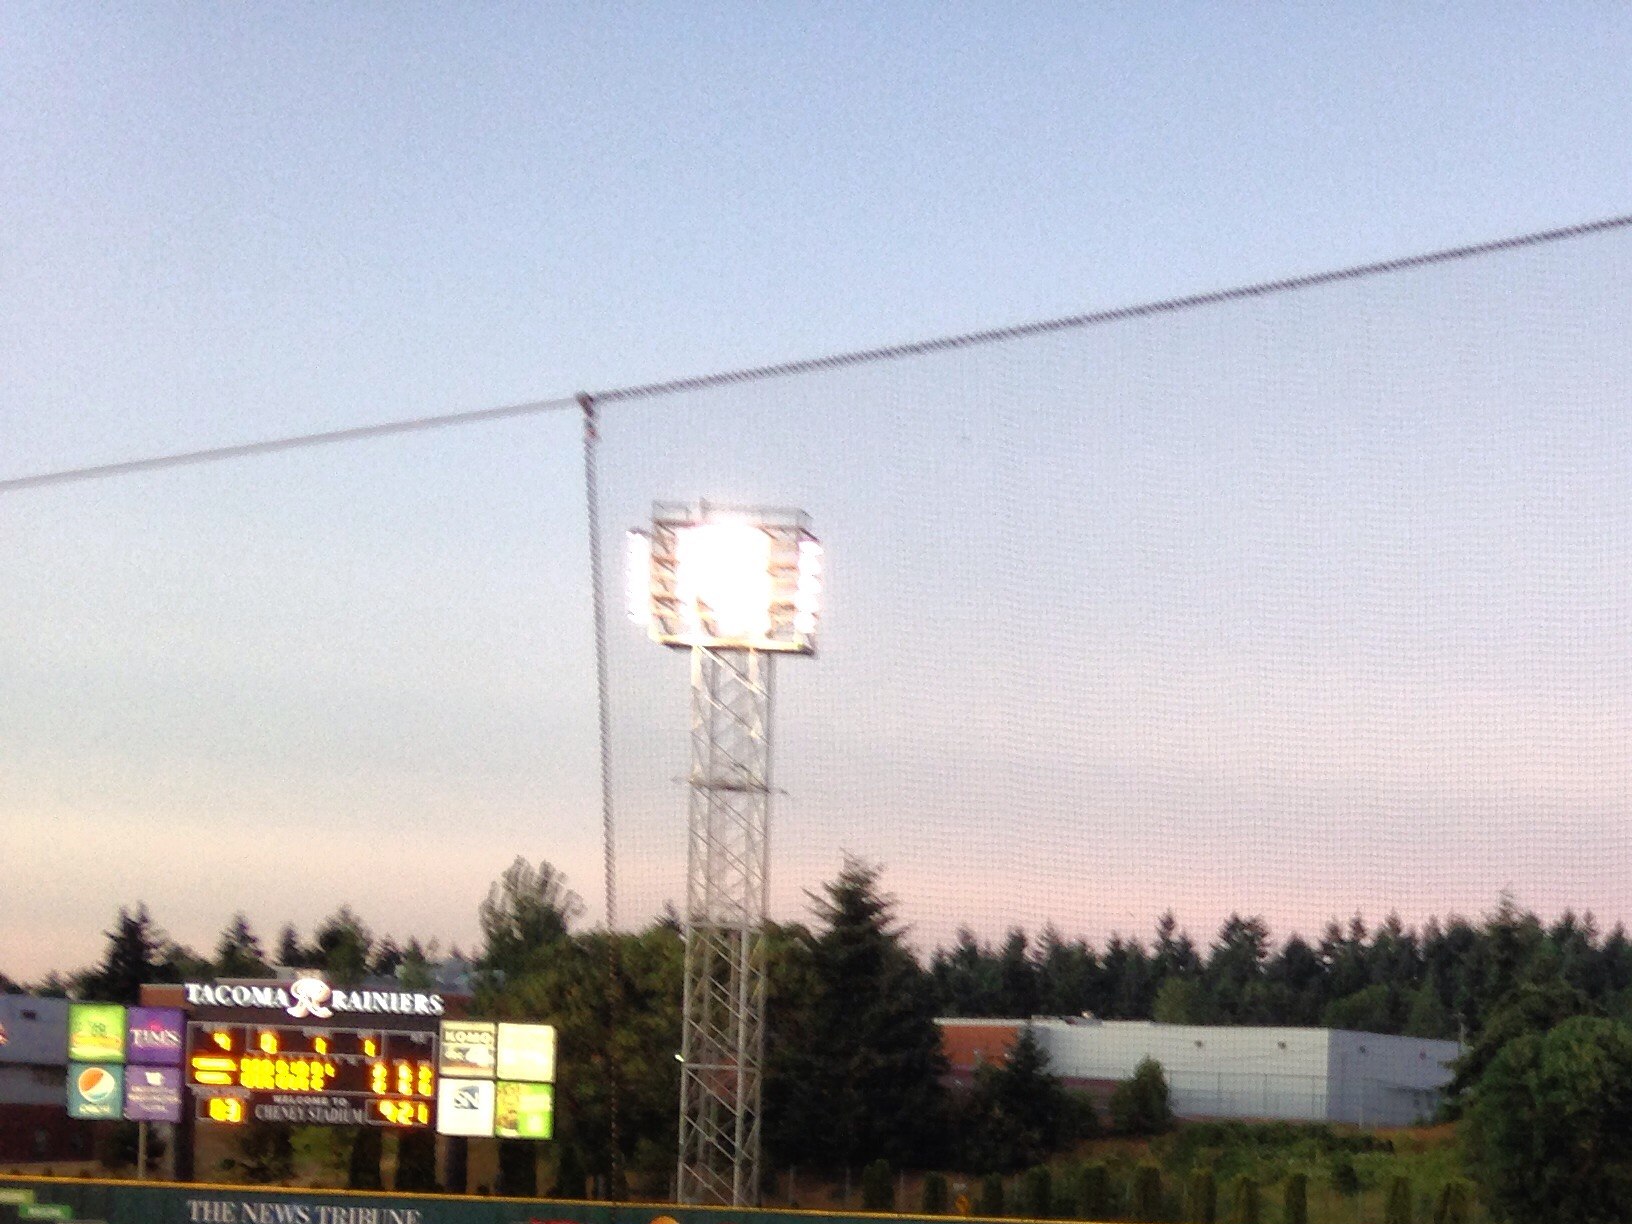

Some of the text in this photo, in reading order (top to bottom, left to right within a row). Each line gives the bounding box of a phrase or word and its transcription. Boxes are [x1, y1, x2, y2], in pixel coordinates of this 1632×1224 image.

[185, 983, 290, 1007] TACOMA
[331, 991, 445, 1015] RAINIERS
[187, 1200, 236, 1224] THE
